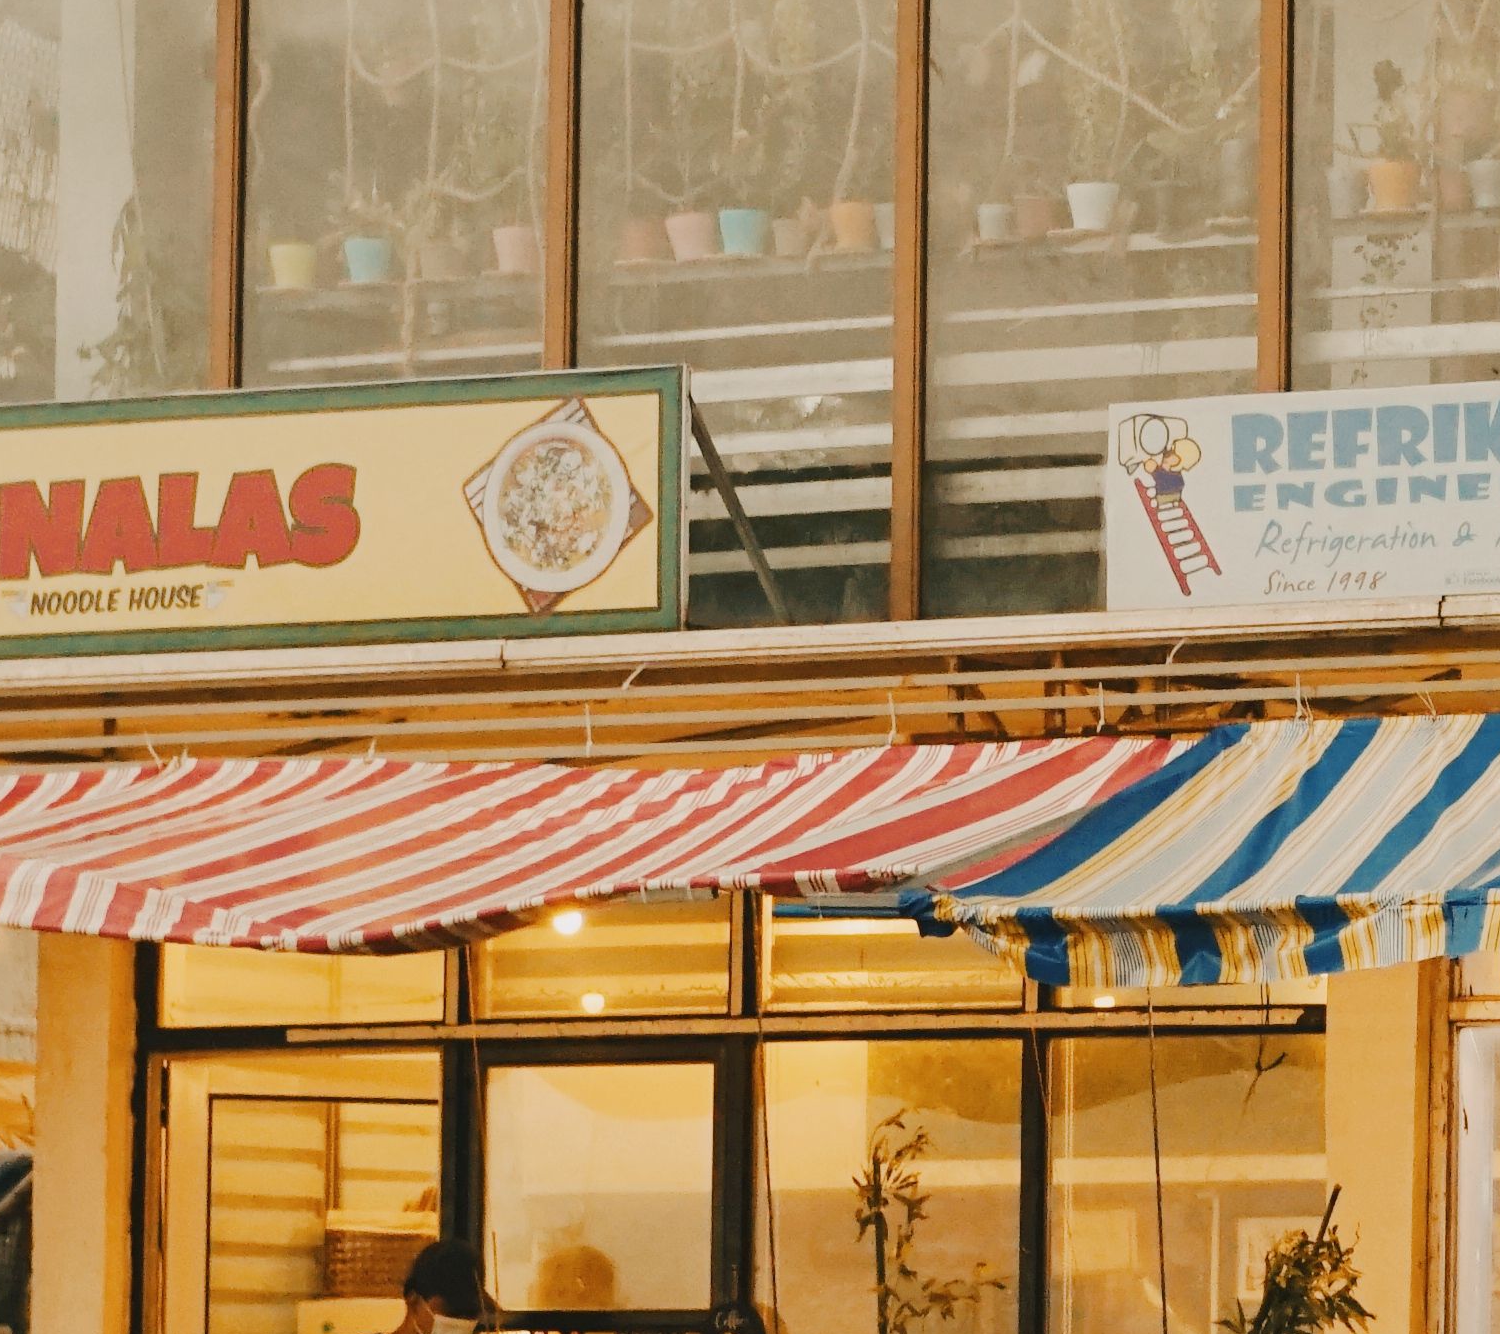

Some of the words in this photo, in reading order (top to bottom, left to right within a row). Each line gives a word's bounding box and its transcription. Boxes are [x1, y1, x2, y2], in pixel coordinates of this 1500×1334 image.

[1254, 520, 1439, 567] Refrigeration
[1452, 522, 1478, 546] &
[1263, 571, 1316, 595] Since
[1327, 571, 1387, 592] 1998
[30, 588, 119, 615] NOODLE
[129, 585, 204, 611] HOUSE
